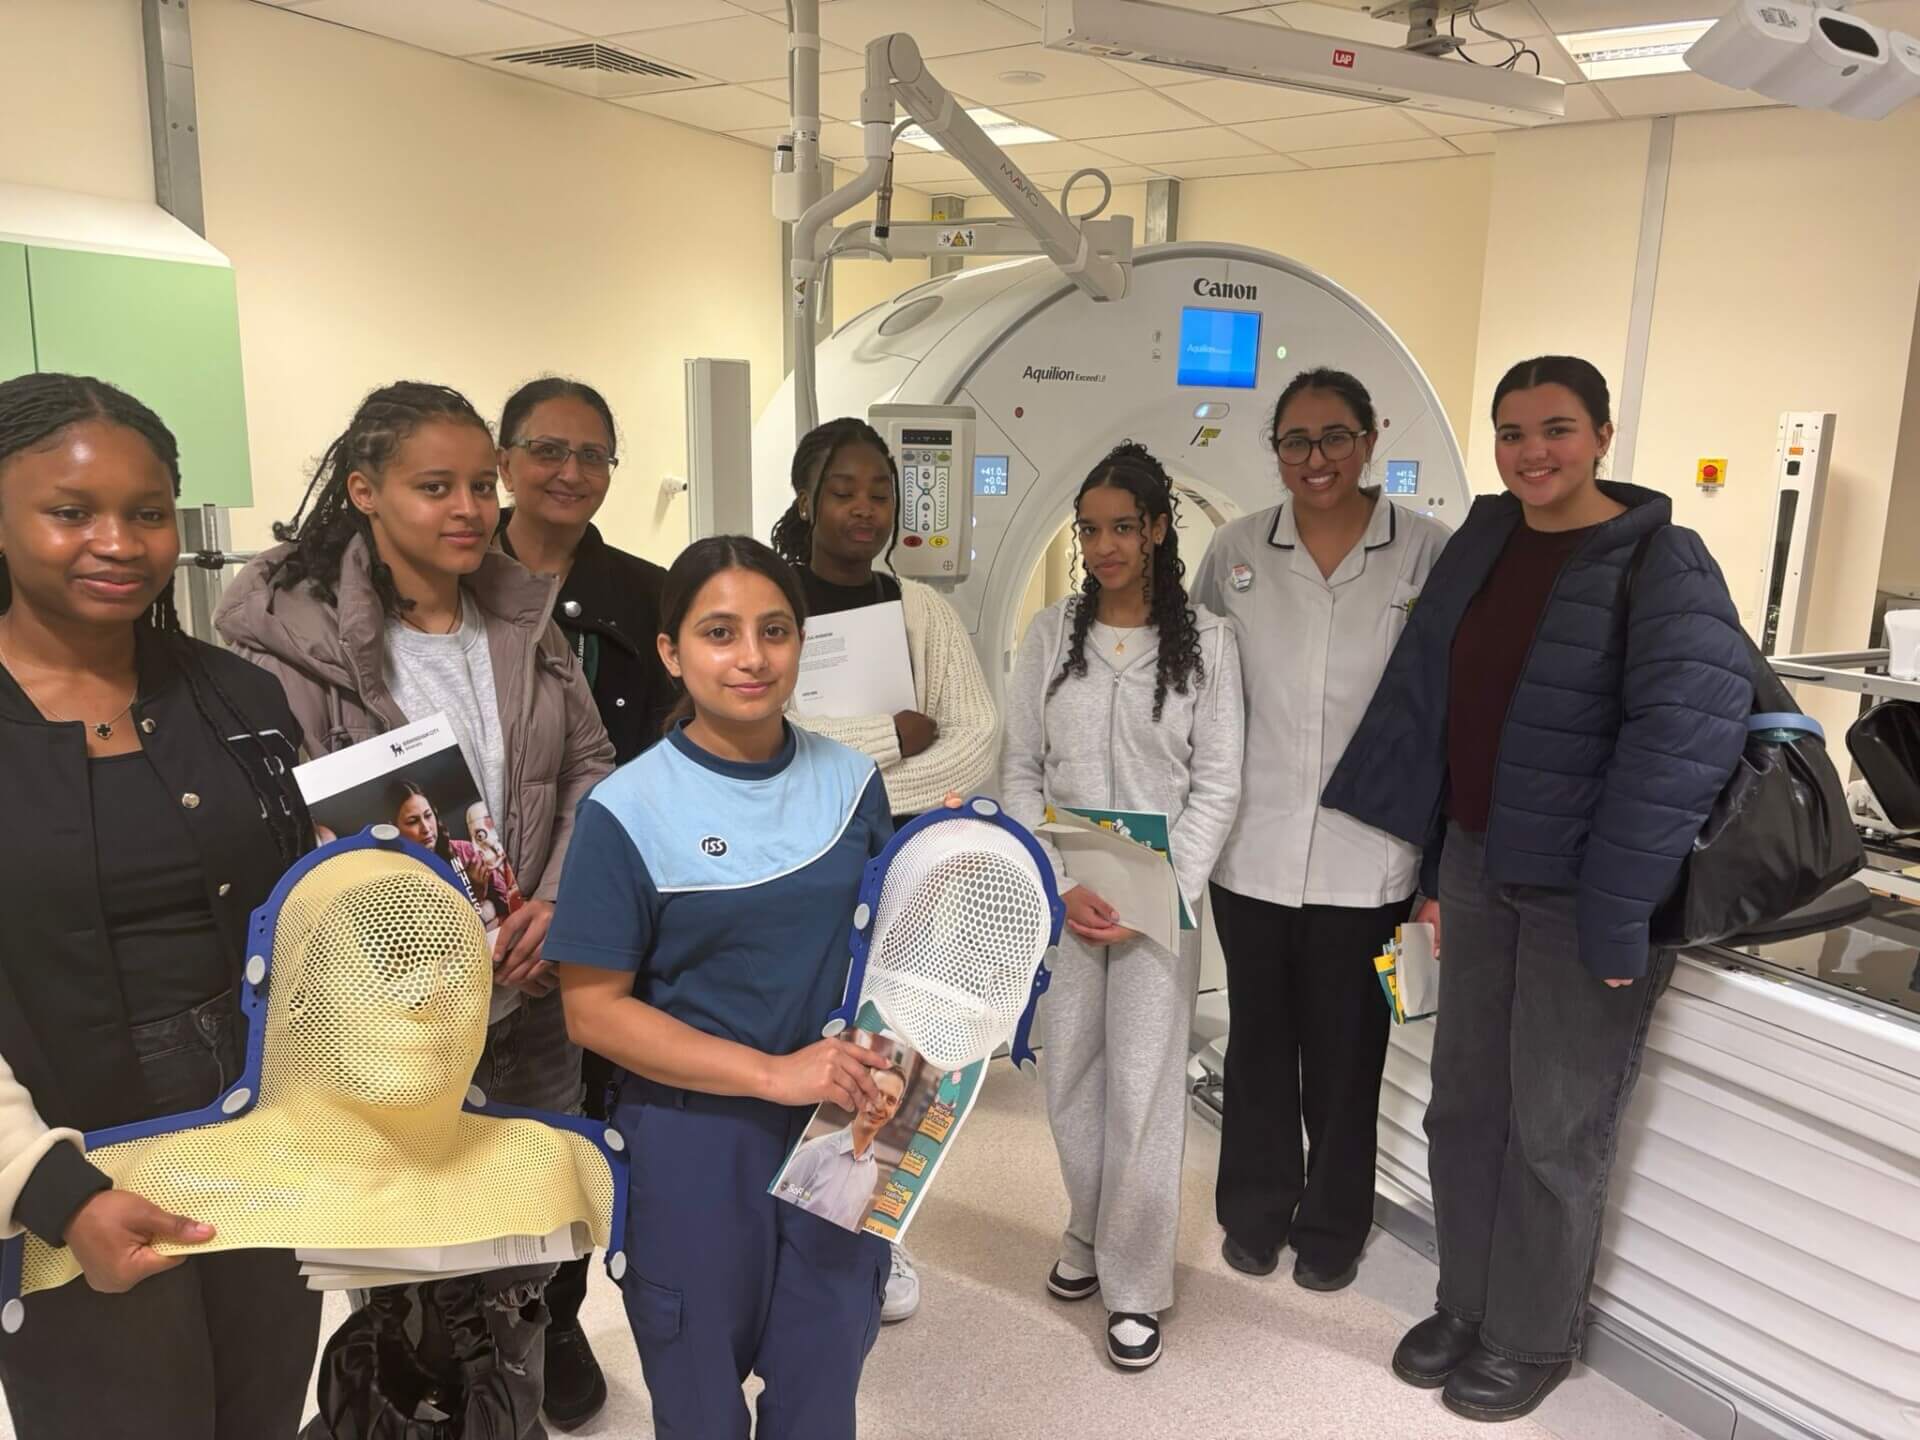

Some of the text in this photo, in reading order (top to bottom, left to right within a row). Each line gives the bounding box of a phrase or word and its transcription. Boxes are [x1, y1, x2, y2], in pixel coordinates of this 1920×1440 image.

[1335, 52, 1353, 65] LAP
[1193, 277, 1257, 300] Canon
[1022, 365, 1075, 383] Aquilion
